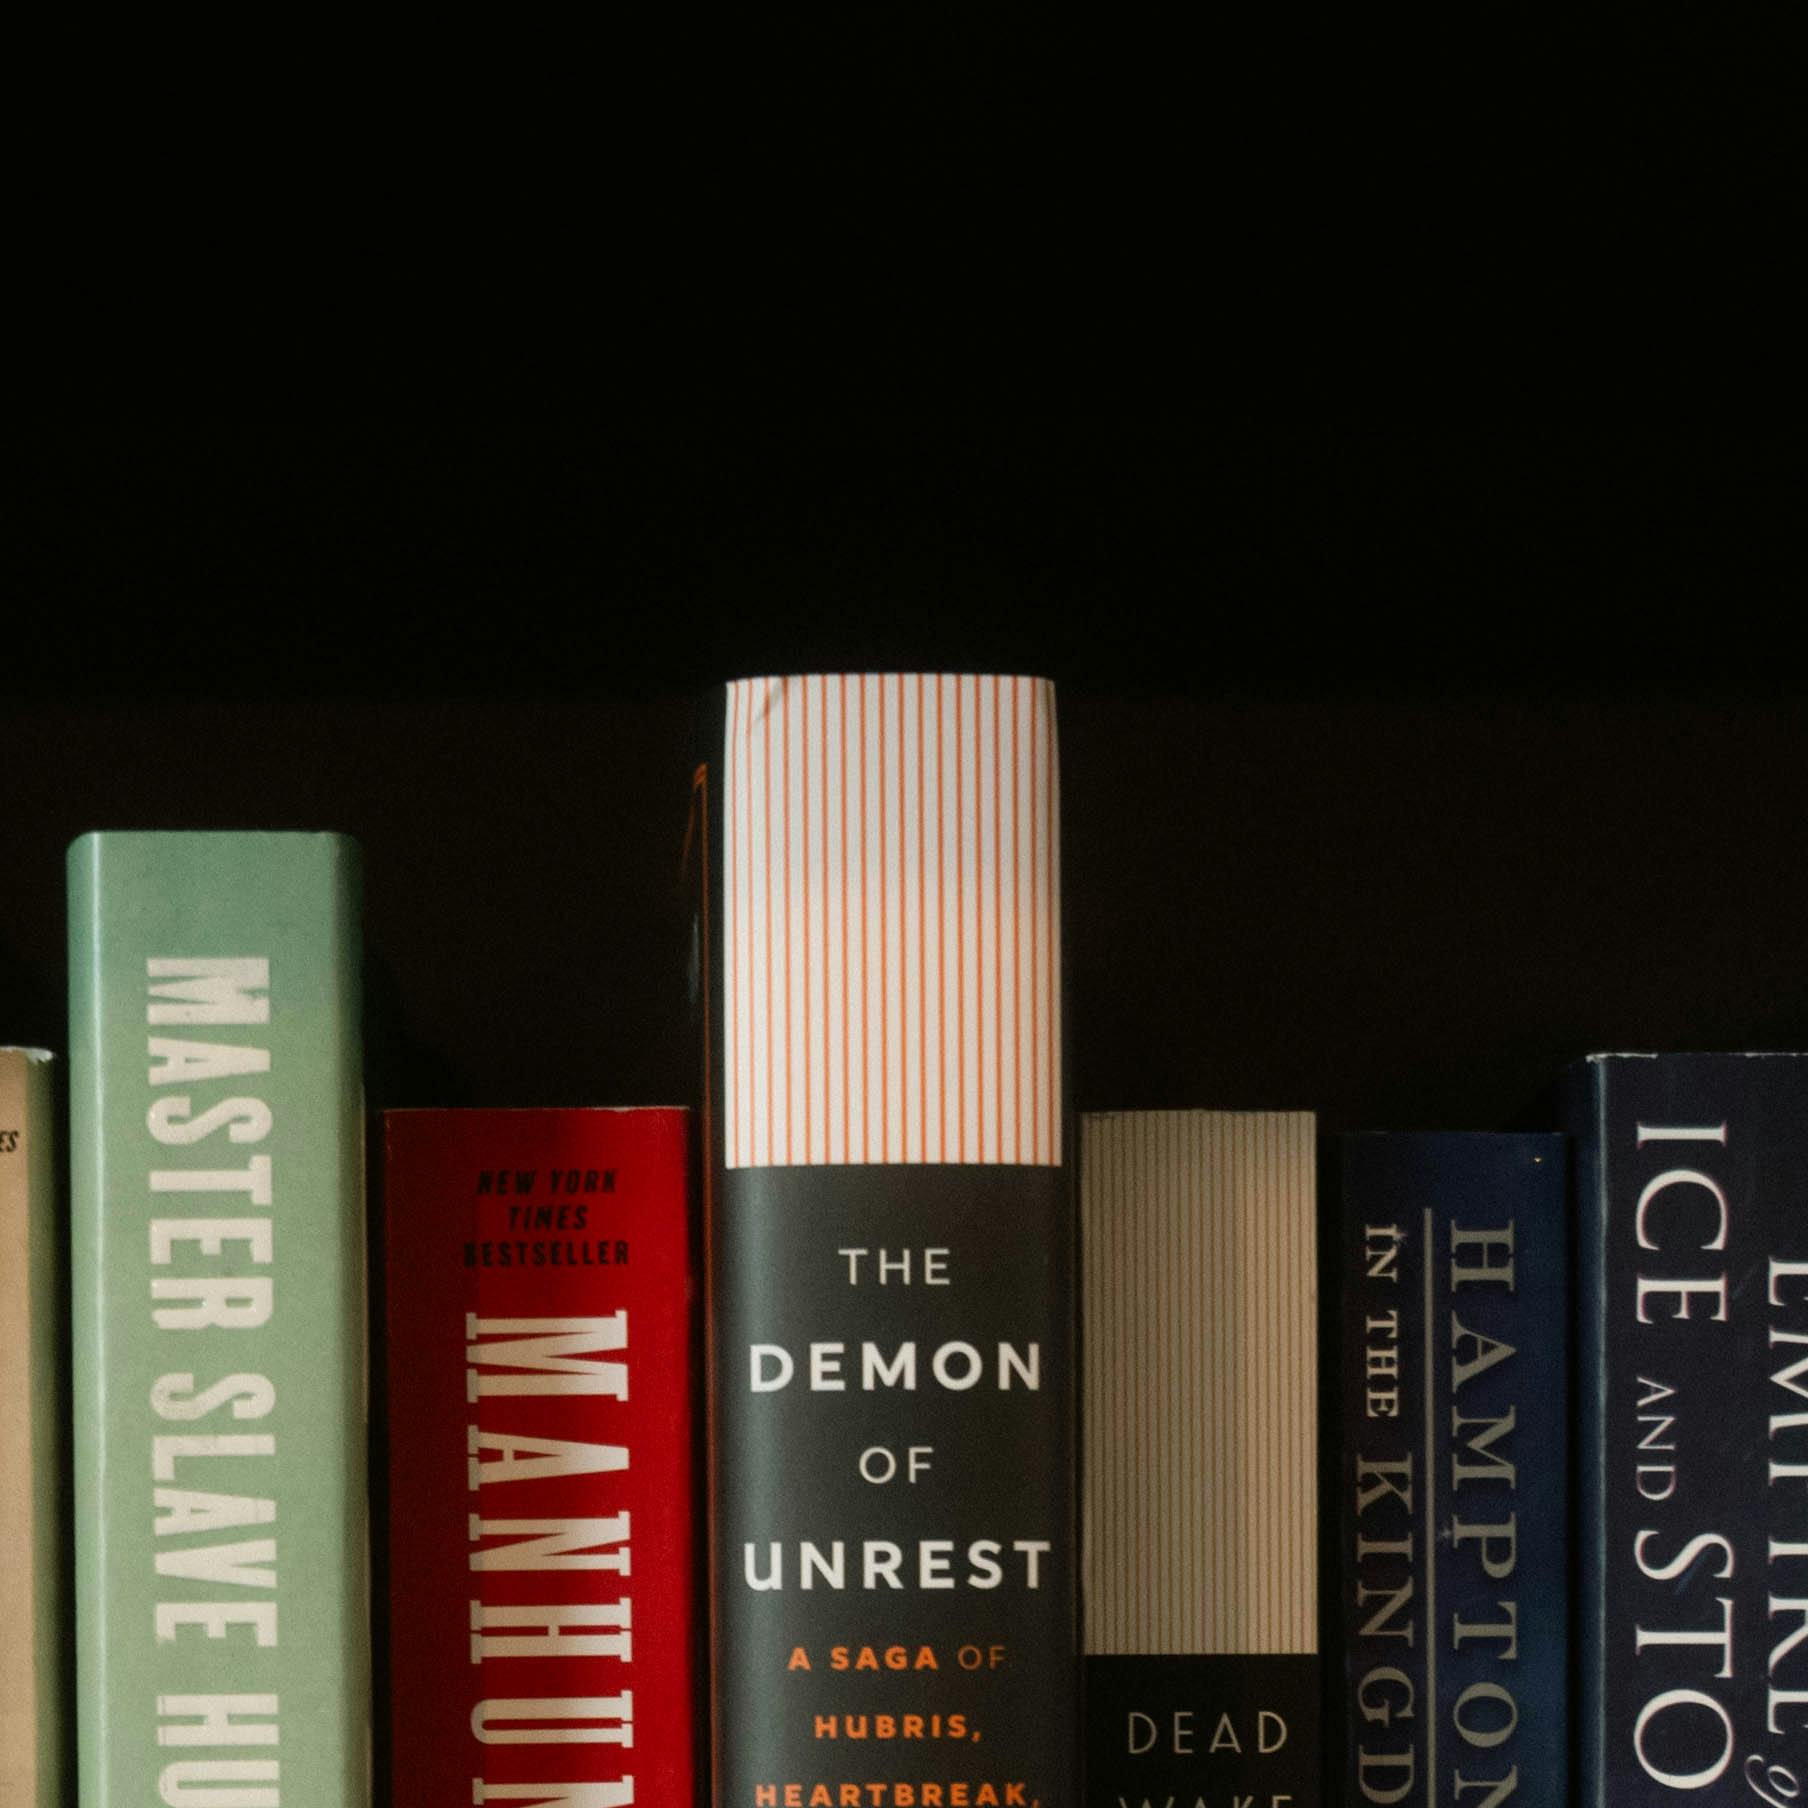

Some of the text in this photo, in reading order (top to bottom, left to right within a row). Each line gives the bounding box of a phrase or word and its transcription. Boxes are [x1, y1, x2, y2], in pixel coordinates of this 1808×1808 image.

[146, 957, 274, 1331] MASTER
[1635, 1120, 1729, 1326] ICE
[838, 1248, 951, 1286] THE
[1364, 1223, 1400, 1284] IN
[749, 1340, 1040, 1393] DEMON
[1364, 1309, 1401, 1420] THE
[1636, 1374, 1679, 1502] AND
[858, 1445, 935, 1485] OF
[149, 1372, 278, 1648] SLAVE
[743, 1539, 1052, 1592] UNREST
[787, 1645, 1007, 1672] A SAGA OF
[814, 1713, 982, 1743] HUBRIS,
[1127, 1710, 1289, 1756] DEAD
